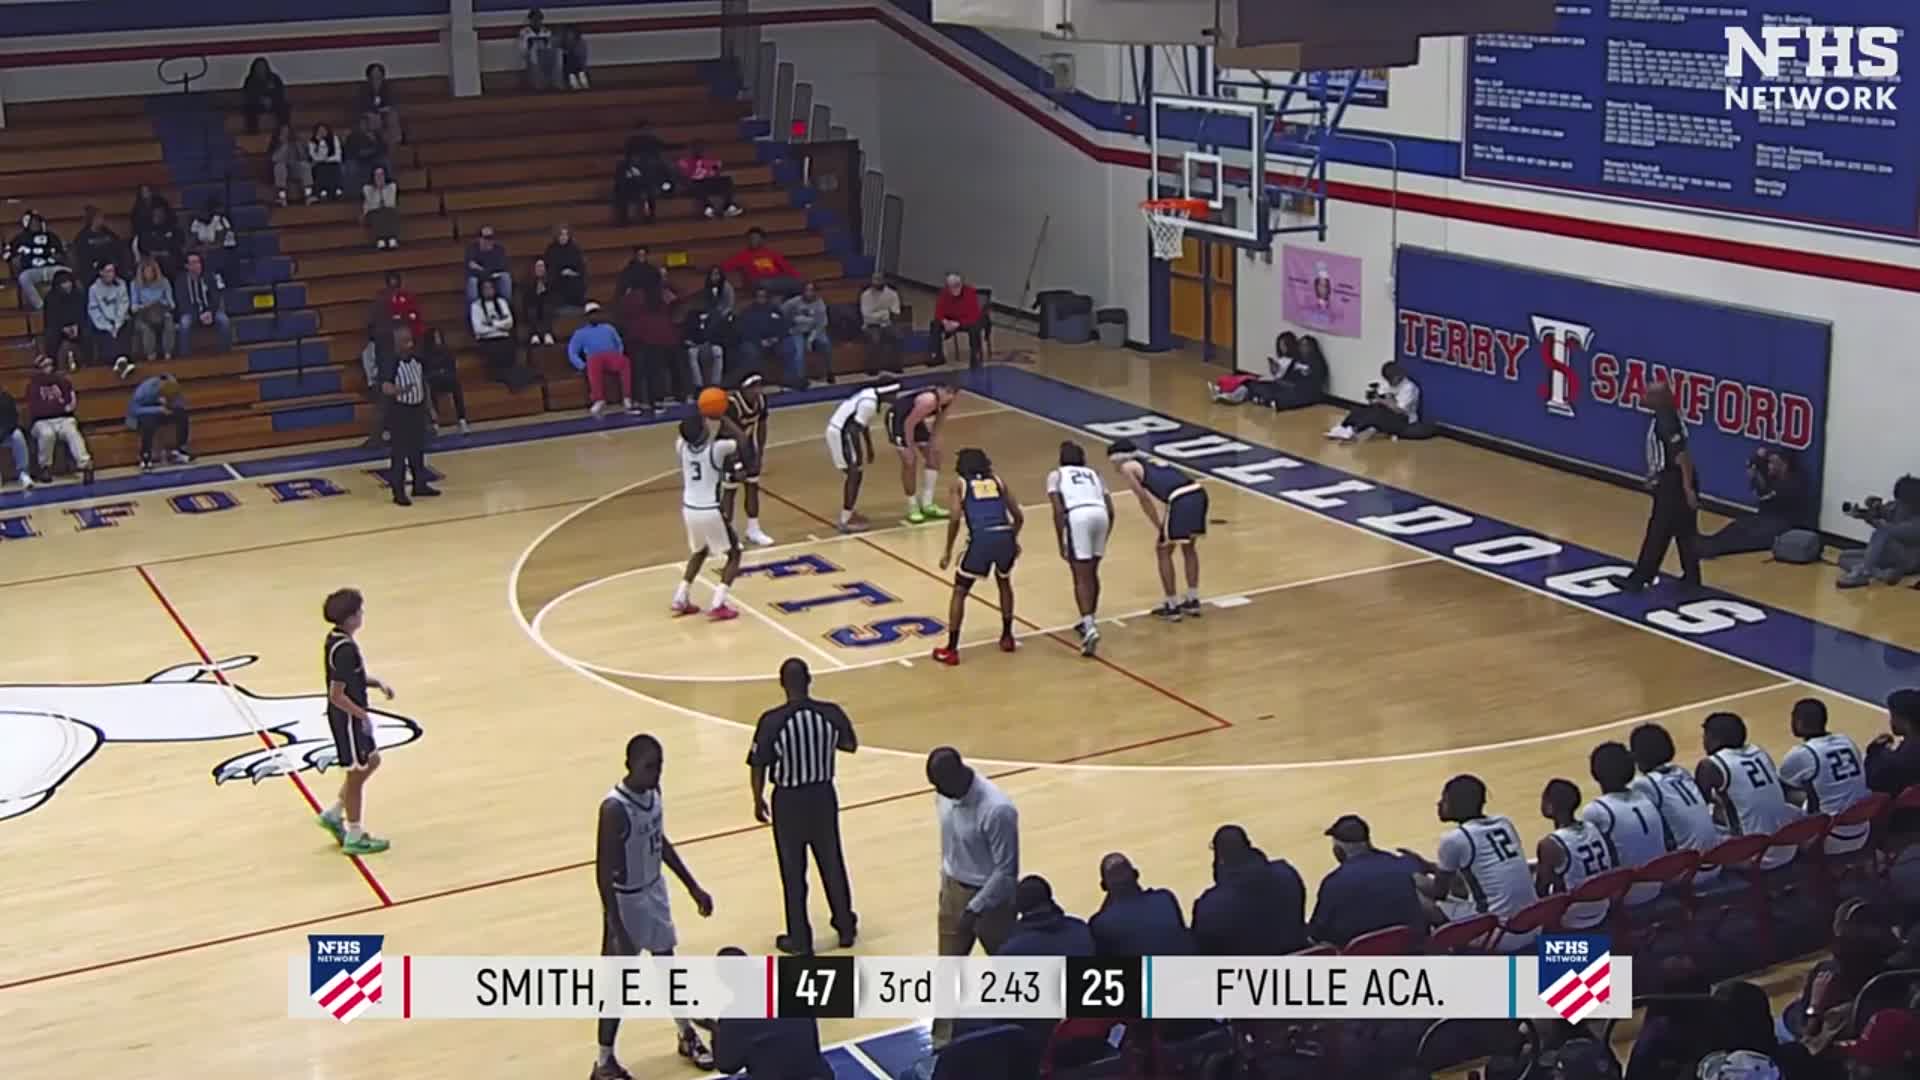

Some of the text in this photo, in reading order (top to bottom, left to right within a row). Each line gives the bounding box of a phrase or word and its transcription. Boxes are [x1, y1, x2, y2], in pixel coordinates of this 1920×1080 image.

[1399, 308, 1814, 451] TERRY SANFORD
[690, 461, 702, 481] 3
[1069, 469, 1097, 486] 24
[1082, 414, 1768, 635] BULLDOGS
[1740, 757, 1774, 788] 21
[1825, 748, 1861, 781] 23
[1670, 779, 1699, 807] 11
[1631, 806, 1650, 836] 1
[1485, 828, 1518, 862] 12
[1578, 840, 1609, 876] 22
